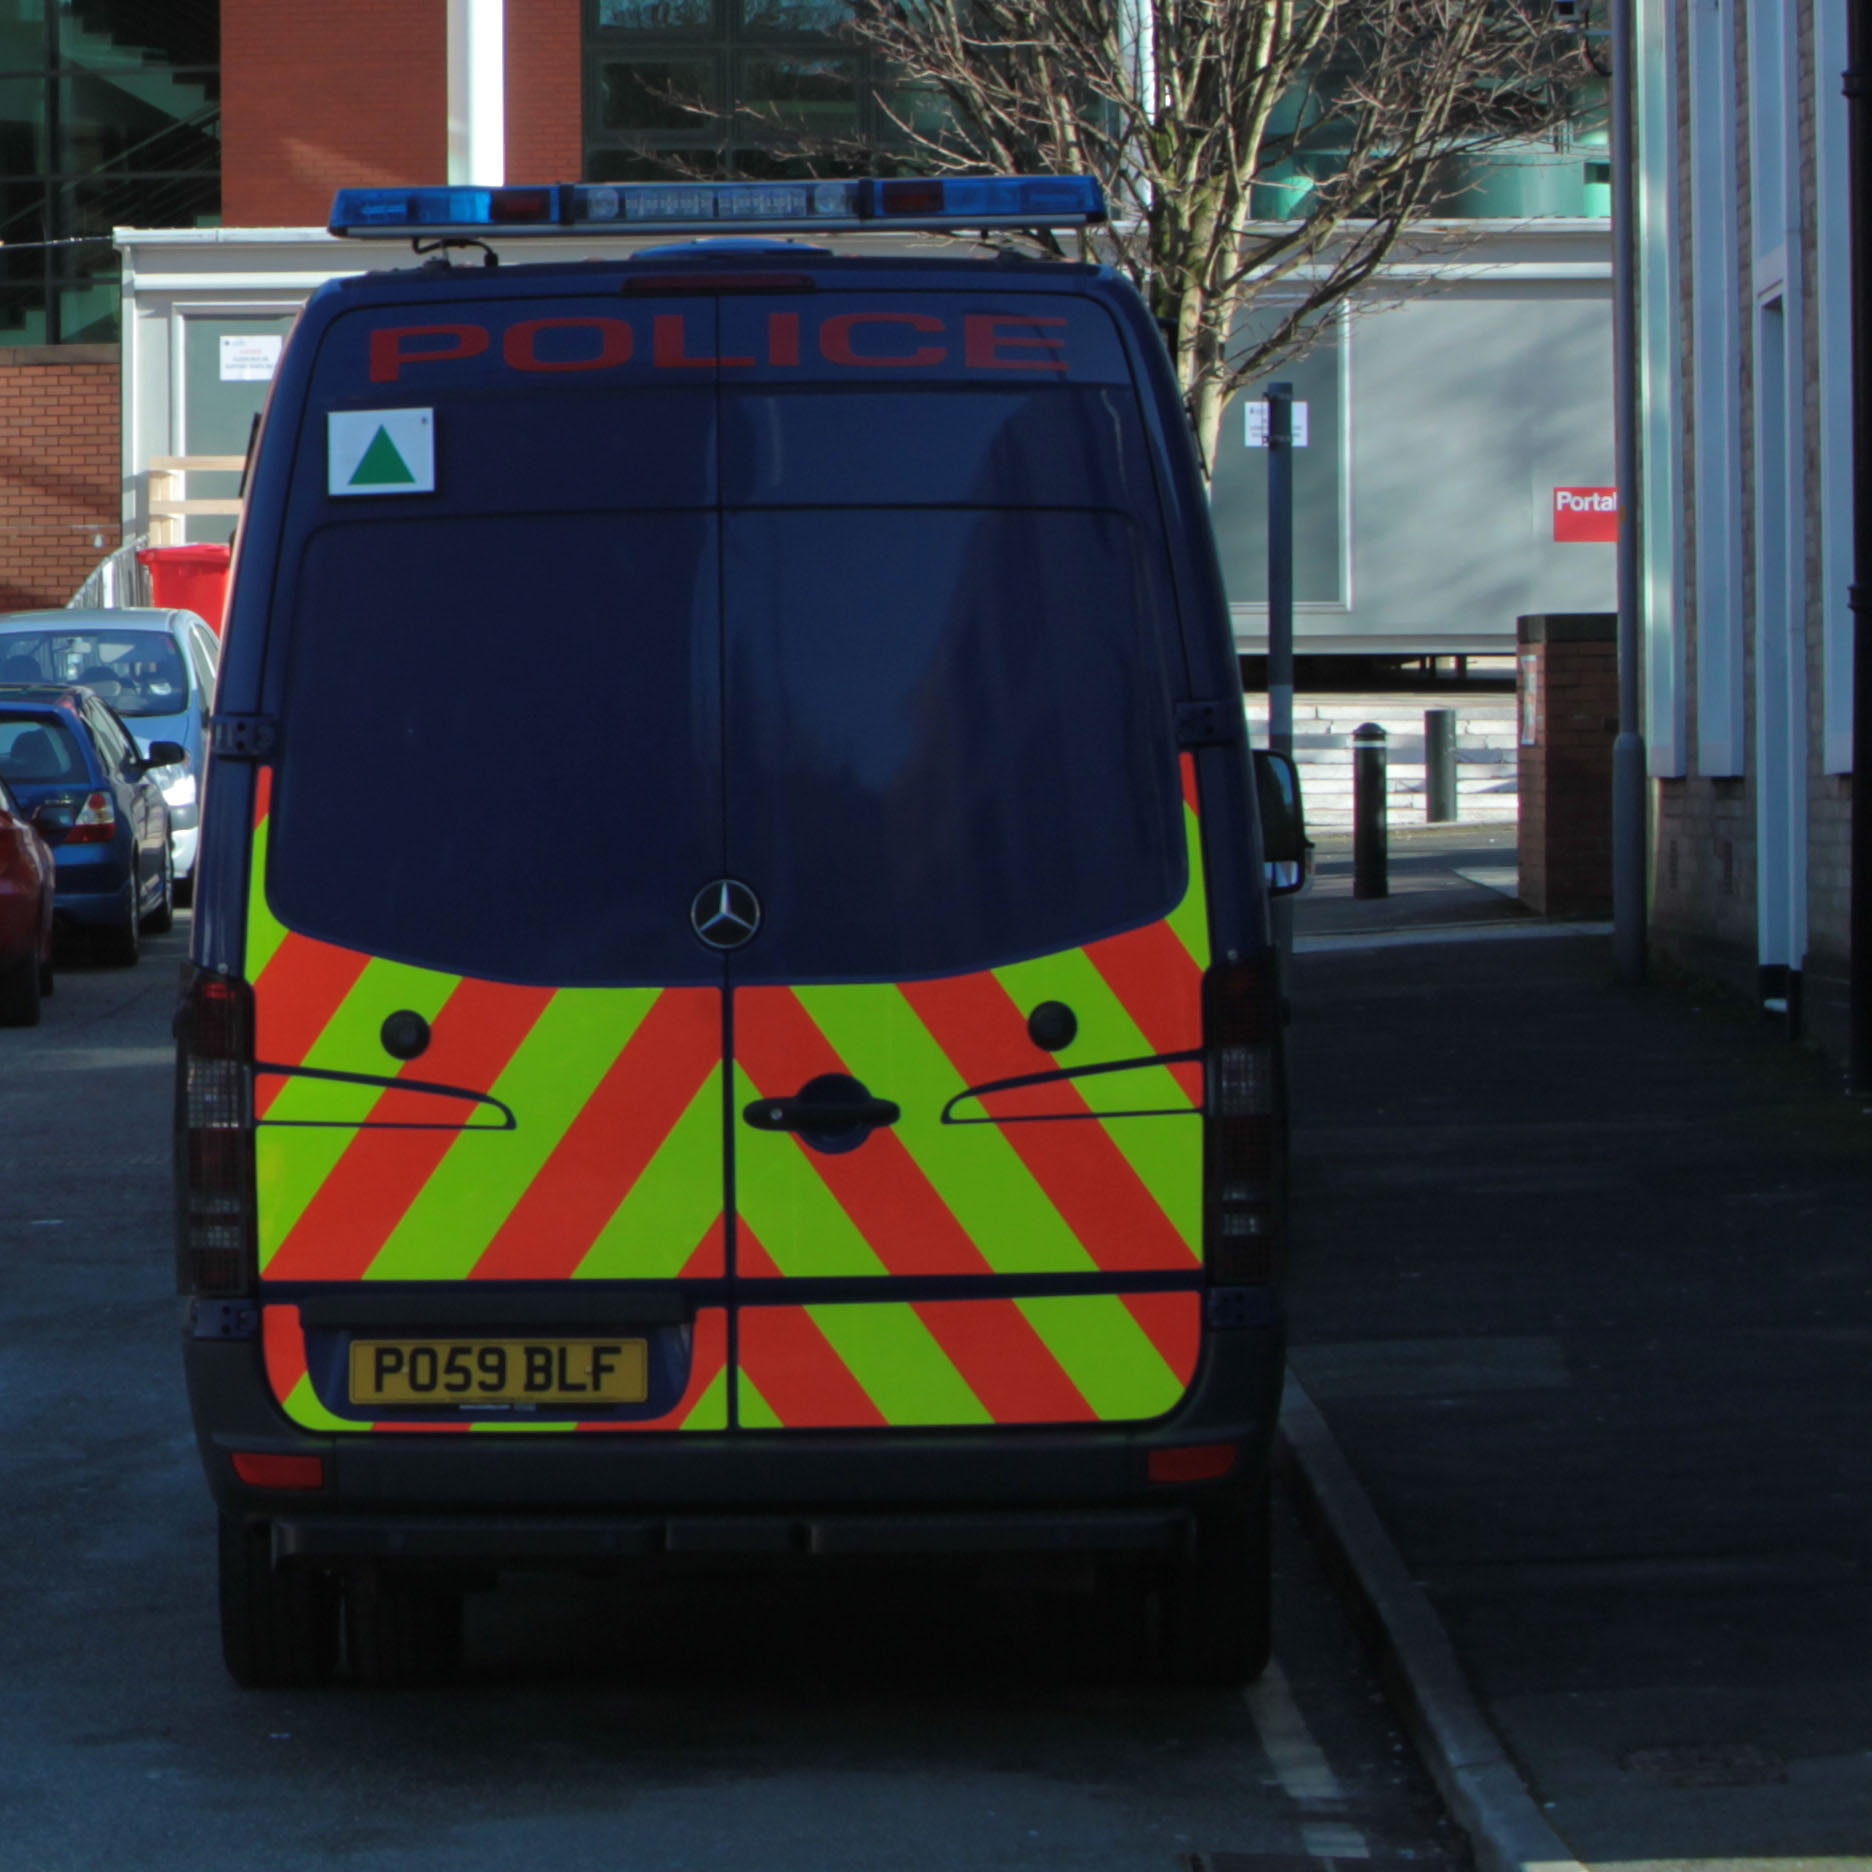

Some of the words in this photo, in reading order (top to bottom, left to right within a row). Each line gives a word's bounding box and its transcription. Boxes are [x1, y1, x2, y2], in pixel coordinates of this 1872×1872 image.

[368, 311, 1071, 383] POLICE
[374, 1346, 507, 1393] PO59
[523, 1345, 623, 1392] BLF
